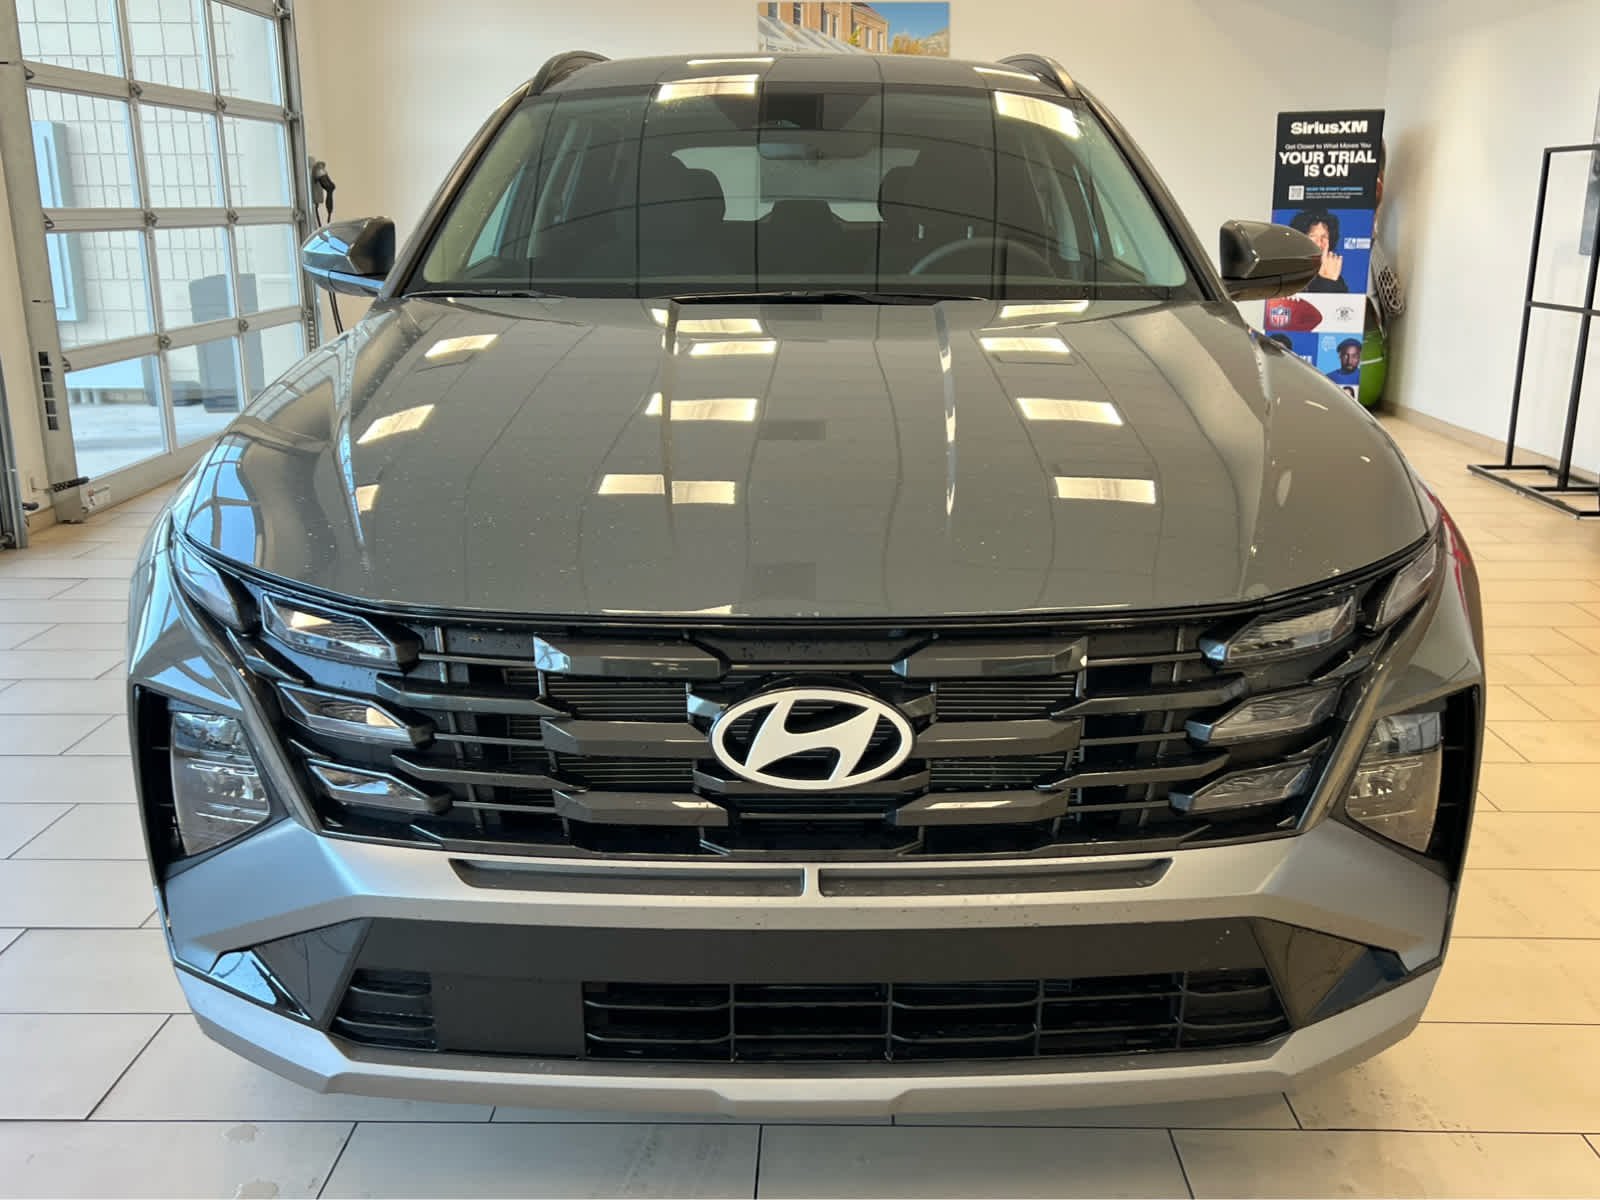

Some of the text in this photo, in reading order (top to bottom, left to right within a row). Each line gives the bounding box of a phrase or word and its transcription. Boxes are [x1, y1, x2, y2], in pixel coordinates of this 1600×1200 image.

[1290, 120, 1368, 135] SiriusXM
[1278, 150, 1377, 165] YOUR TRIAL
[1304, 163, 1349, 177] IS ON
